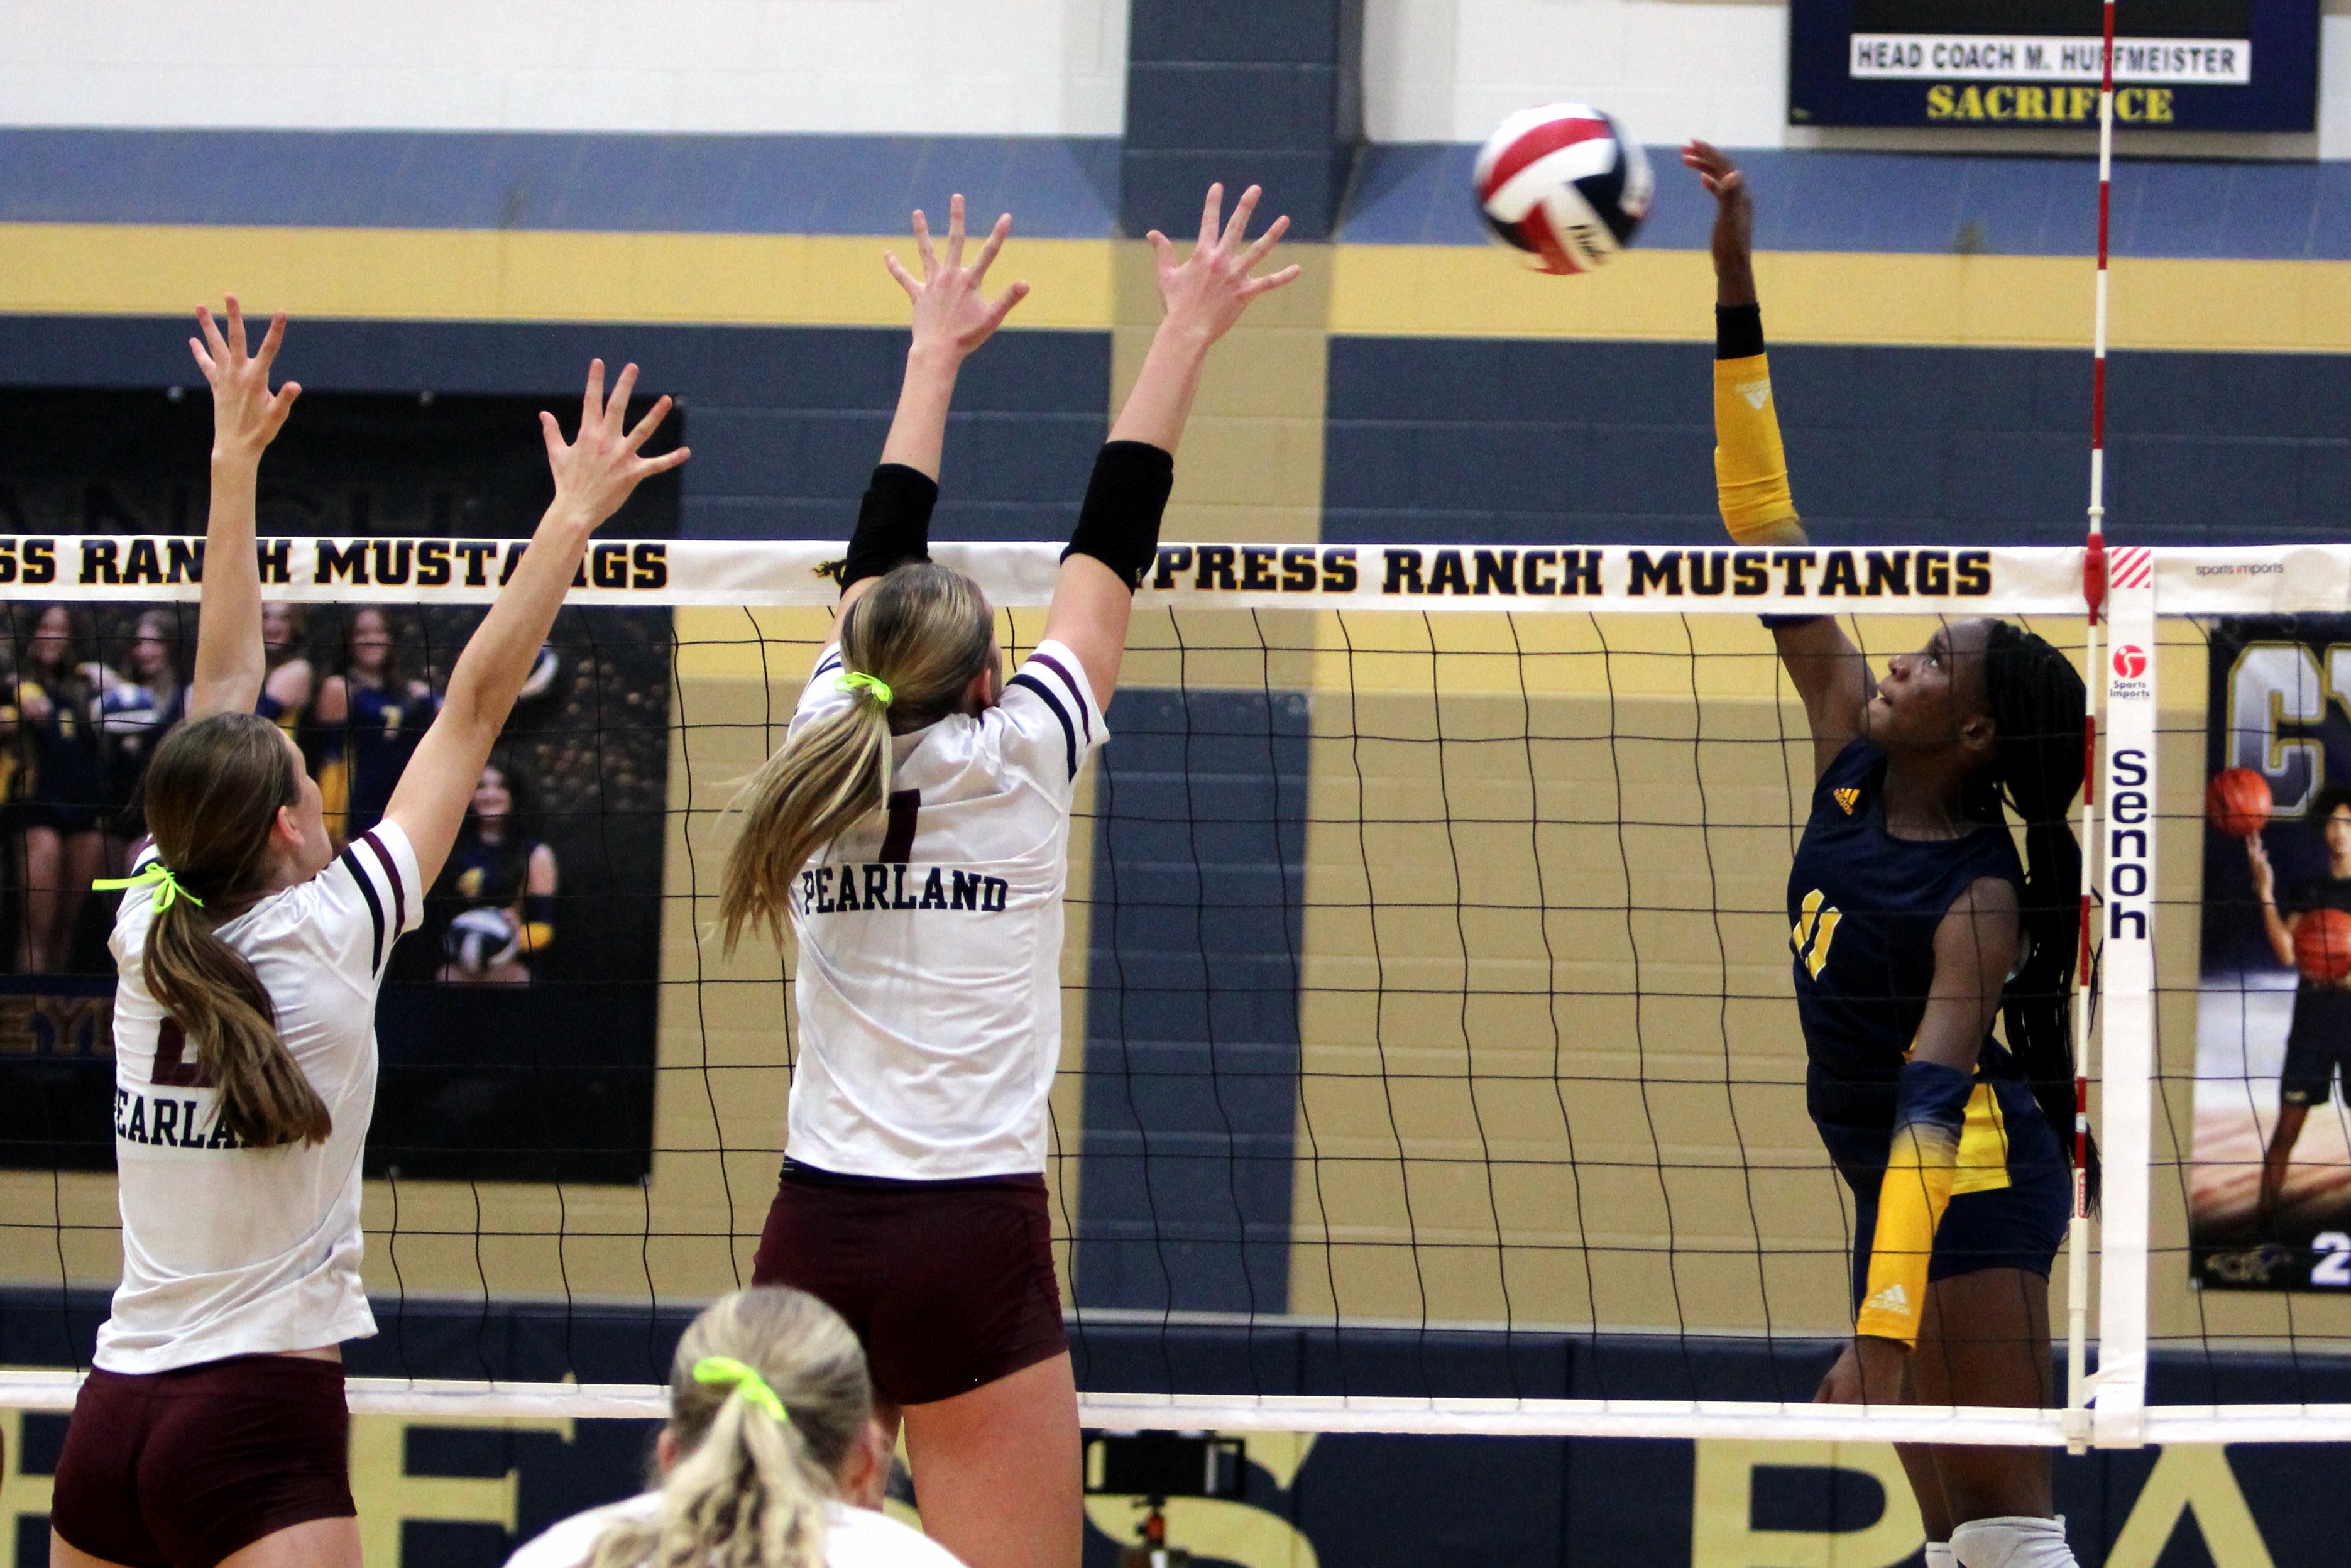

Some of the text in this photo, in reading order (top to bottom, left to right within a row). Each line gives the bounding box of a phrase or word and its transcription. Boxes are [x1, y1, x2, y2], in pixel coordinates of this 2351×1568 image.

[1858, 41, 1922, 69] HEAD
[1932, 43, 2014, 70] COACH
[2025, 44, 2051, 70] M.
[1927, 84, 2174, 122] SACRIFCE
[79, 539, 293, 586] RANH
[315, 539, 669, 591] MUSTGS
[1382, 548, 1604, 597] RANCH
[1627, 549, 1992, 598] MUSTANGS
[2196, 564, 2284, 576] sports imports
[2110, 689, 2150, 699] Imports
[2113, 680, 2146, 690] Sports
[2109, 749, 2148, 940] Senoh
[801, 863, 1008, 914] PEARLAND
